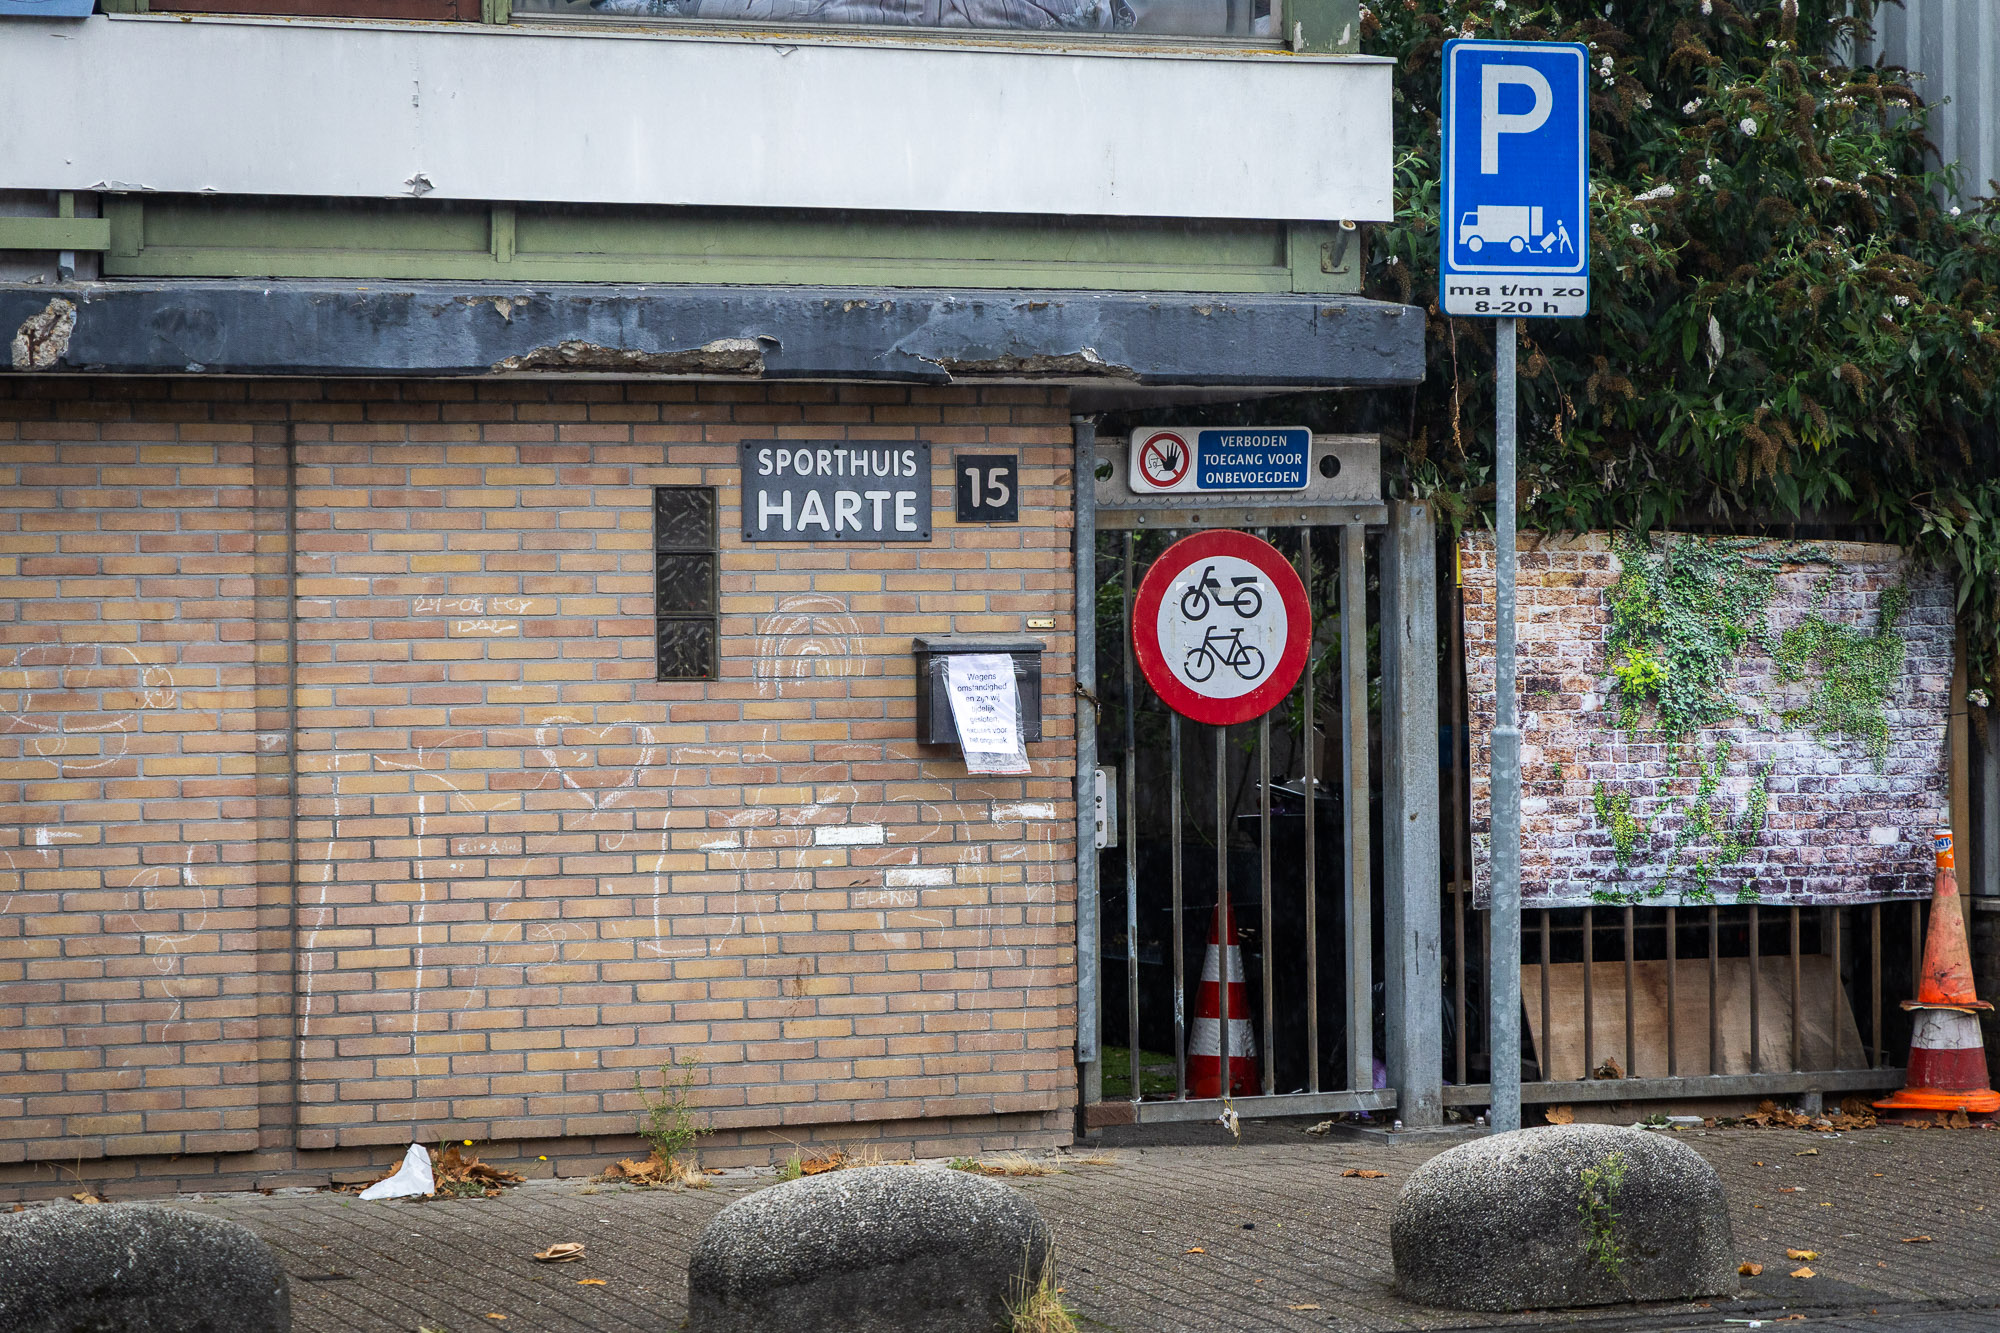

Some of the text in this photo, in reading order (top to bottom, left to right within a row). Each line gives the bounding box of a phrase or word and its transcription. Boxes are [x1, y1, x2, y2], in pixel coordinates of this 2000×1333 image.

[1481, 64, 1553, 174] P
[1450, 284, 1585, 297] ma t/m zo
[1475, 301, 1559, 314] 8-20 h
[1220, 435, 1287, 447] VERBODEN
[758, 449, 917, 477] SPORTHUIS
[1203, 453, 1302, 466] TOEGANG VOOR
[1205, 471, 1299, 484] ONBEVOEGDEN
[965, 467, 1010, 508] 15
[758, 489, 918, 532] HARTE
[966, 673, 997, 682] Wegens
[990, 693, 1001, 703] wij
[971, 704, 996, 714] tijdelijk
